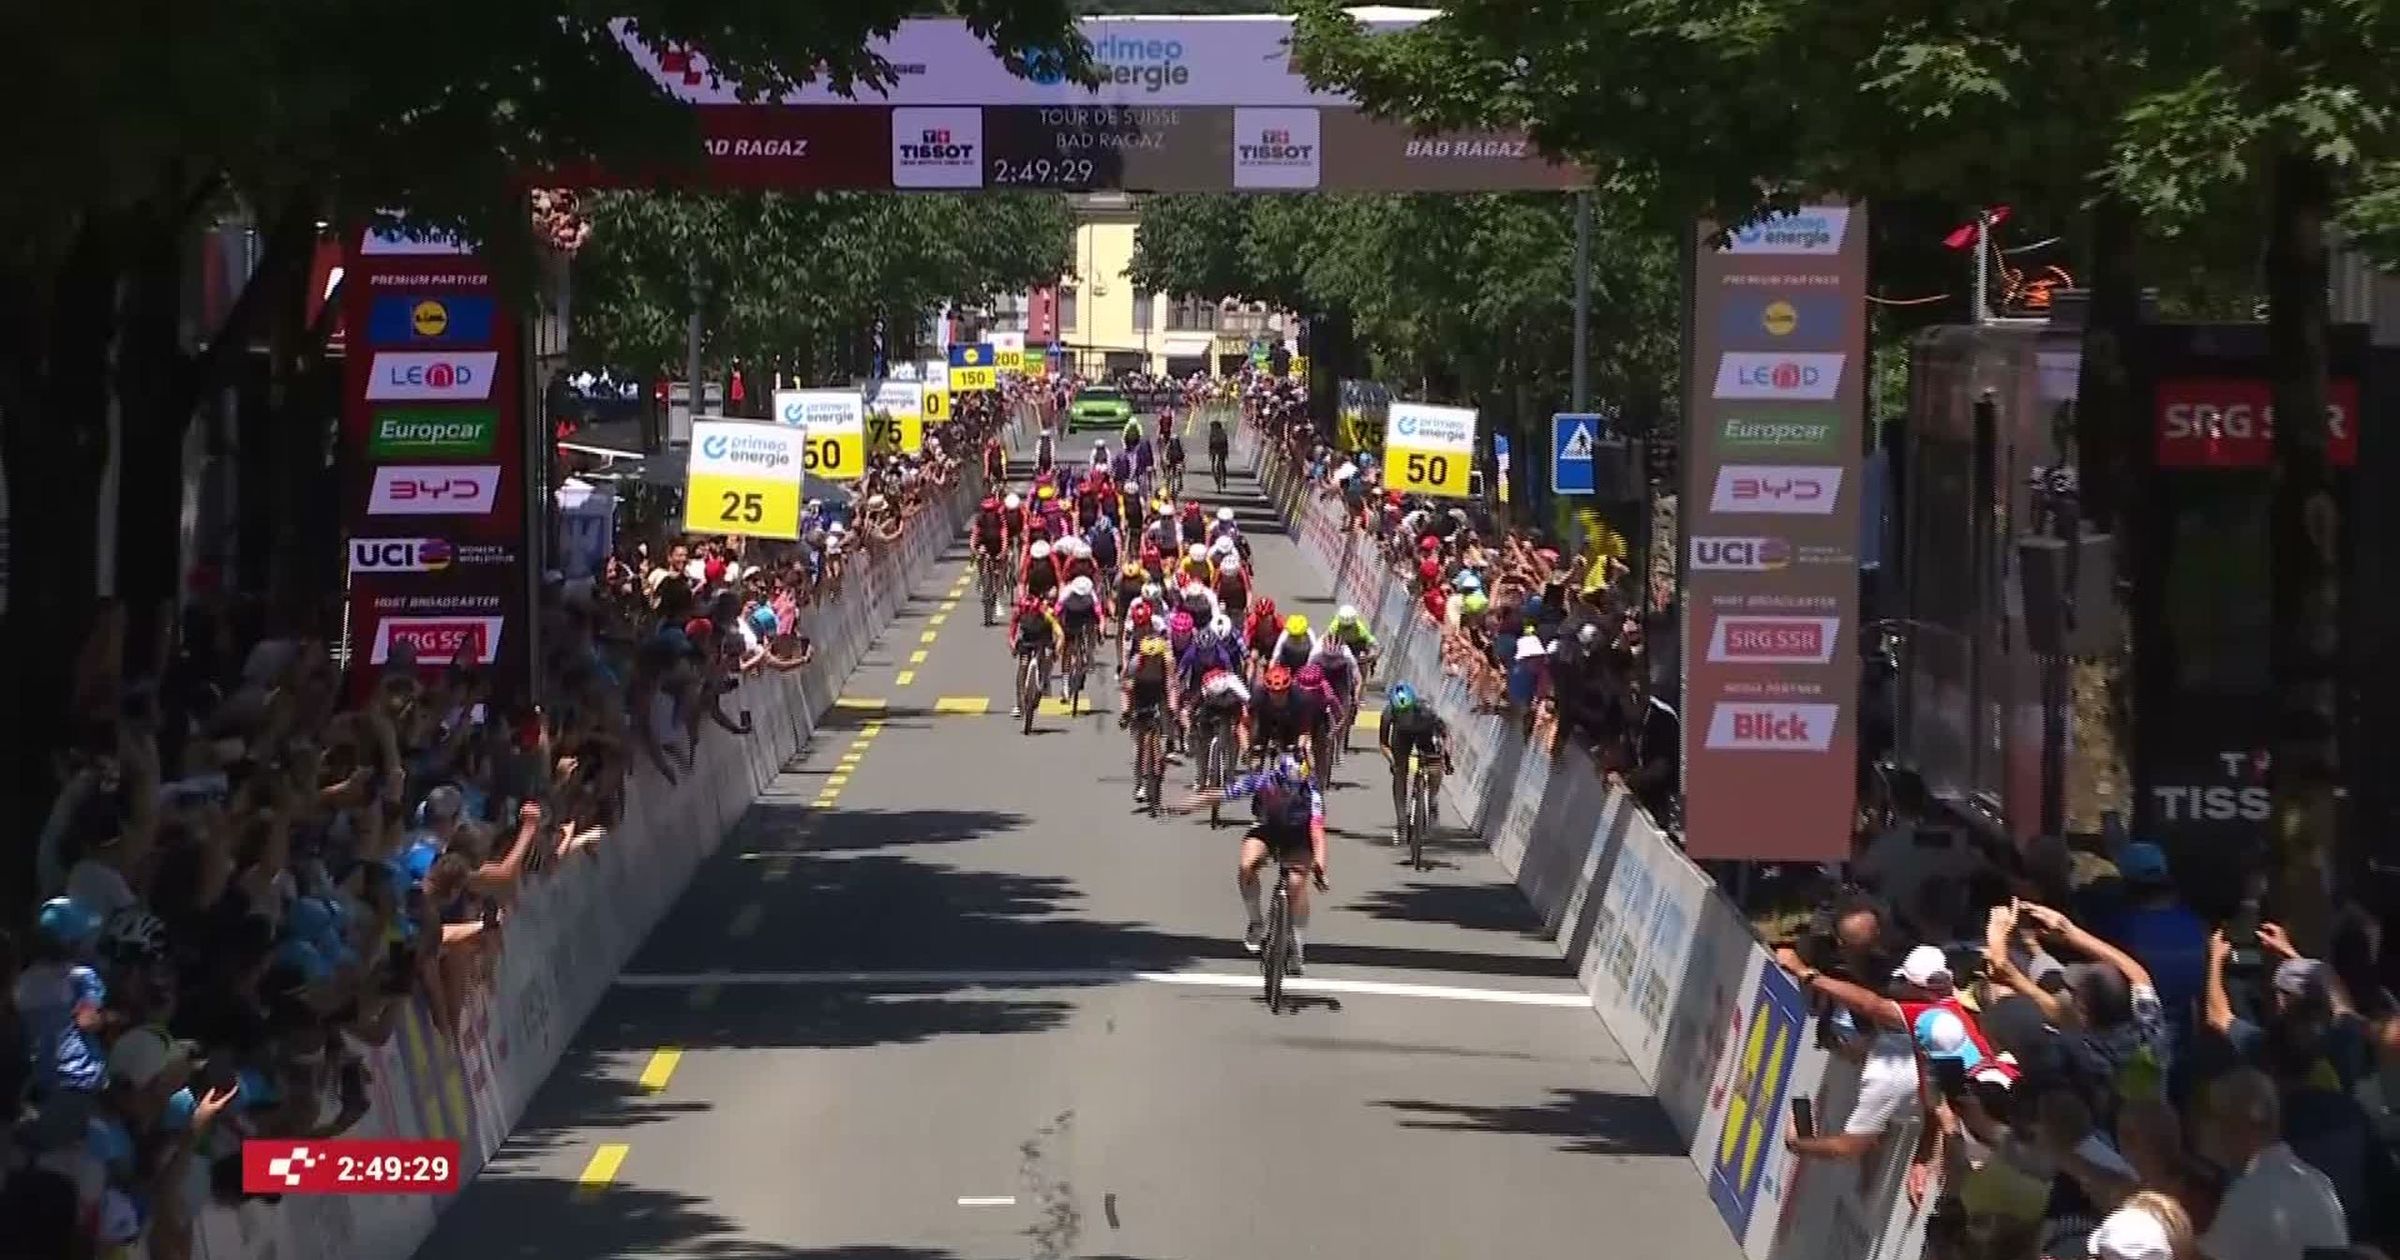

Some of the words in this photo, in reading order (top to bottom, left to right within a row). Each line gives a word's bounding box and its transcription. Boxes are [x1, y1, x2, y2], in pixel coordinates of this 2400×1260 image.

[1097, 34, 1183, 60] rimeo
[1102, 60, 1189, 92] ergie
[1040, 109, 1089, 125] TOUR
[1095, 109, 1118, 125] DE
[1123, 109, 1180, 125] SUISSE
[704, 139, 730, 156] AD
[734, 139, 808, 156] RAGAZ
[900, 145, 973, 159] TISSOT
[1056, 133, 1094, 148] BAD
[1099, 133, 1165, 149] RAGAZ
[1239, 144, 1313, 159] TISSOT
[1405, 141, 1449, 156] BAD
[1453, 141, 1527, 157] RAGAZ
[994, 158, 1093, 183] 2:49:29
[370, 274, 430, 285] PREMIUM
[961, 371, 985, 386] 150
[806, 411, 854, 425] energie
[2164, 404, 2253, 440] SRG
[379, 420, 485, 445] Europcar
[731, 434, 787, 452] primeo
[868, 419, 903, 445] 75
[1724, 419, 1829, 445] Europcar
[729, 450, 789, 468] energie
[804, 438, 841, 470] 50
[1407, 453, 1448, 485] 50
[390, 479, 480, 499] BYD
[1732, 479, 1822, 499] BYD
[720, 490, 763, 523] 25
[356, 543, 415, 567] UCI
[1697, 541, 1753, 565] UCI
[1731, 630, 1772, 649] SRG
[1776, 630, 1817, 649] SSR
[1734, 711, 1809, 741] Blick
[2152, 785, 2271, 820] TISS
